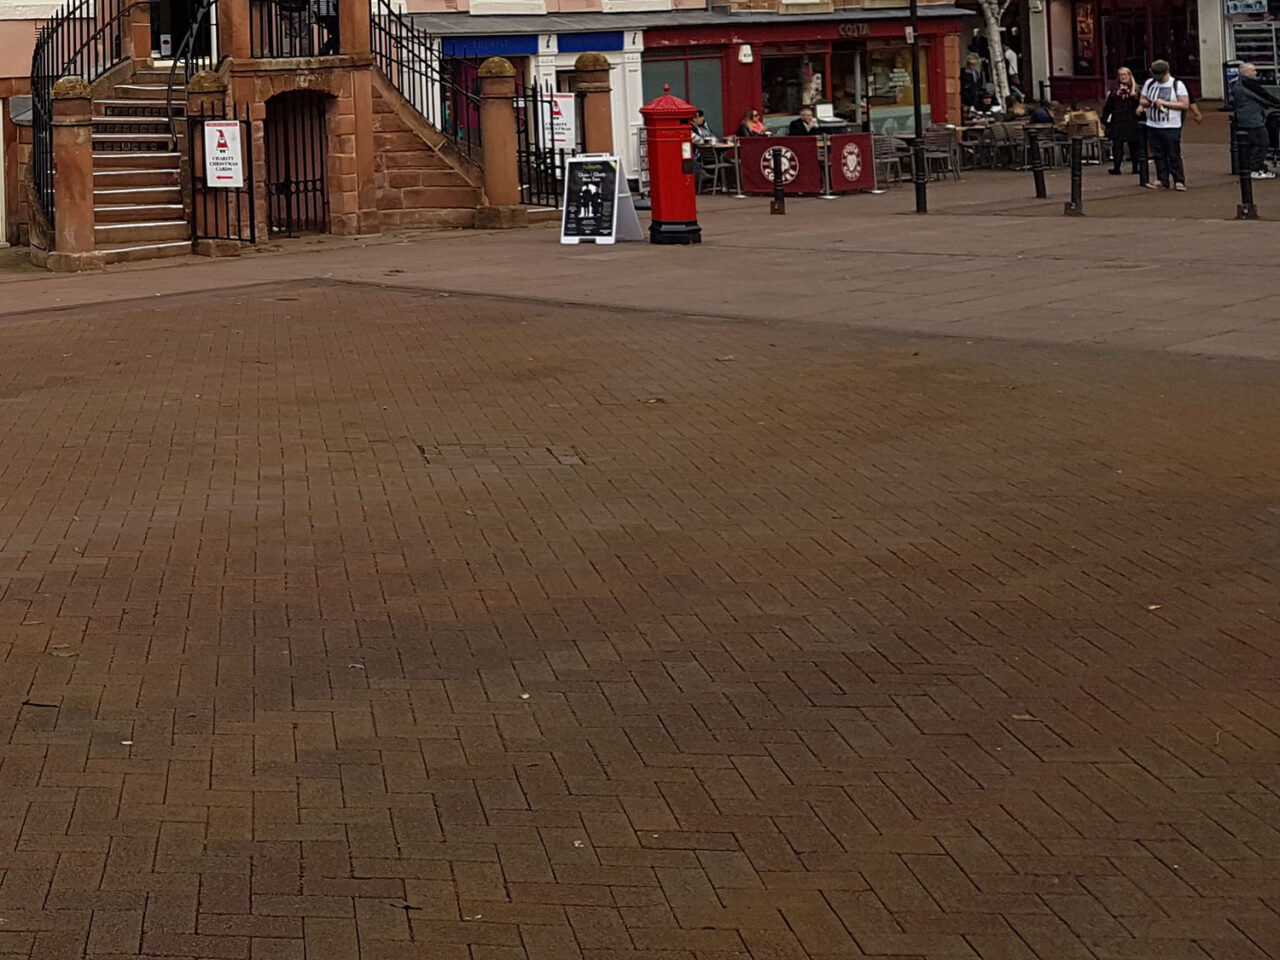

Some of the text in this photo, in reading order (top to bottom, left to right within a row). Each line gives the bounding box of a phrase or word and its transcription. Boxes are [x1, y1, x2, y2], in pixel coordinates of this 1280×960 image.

[839, 23, 869, 36] COSTA
[764, 148, 792, 160] CTA
[764, 168, 796, 181] COEE
